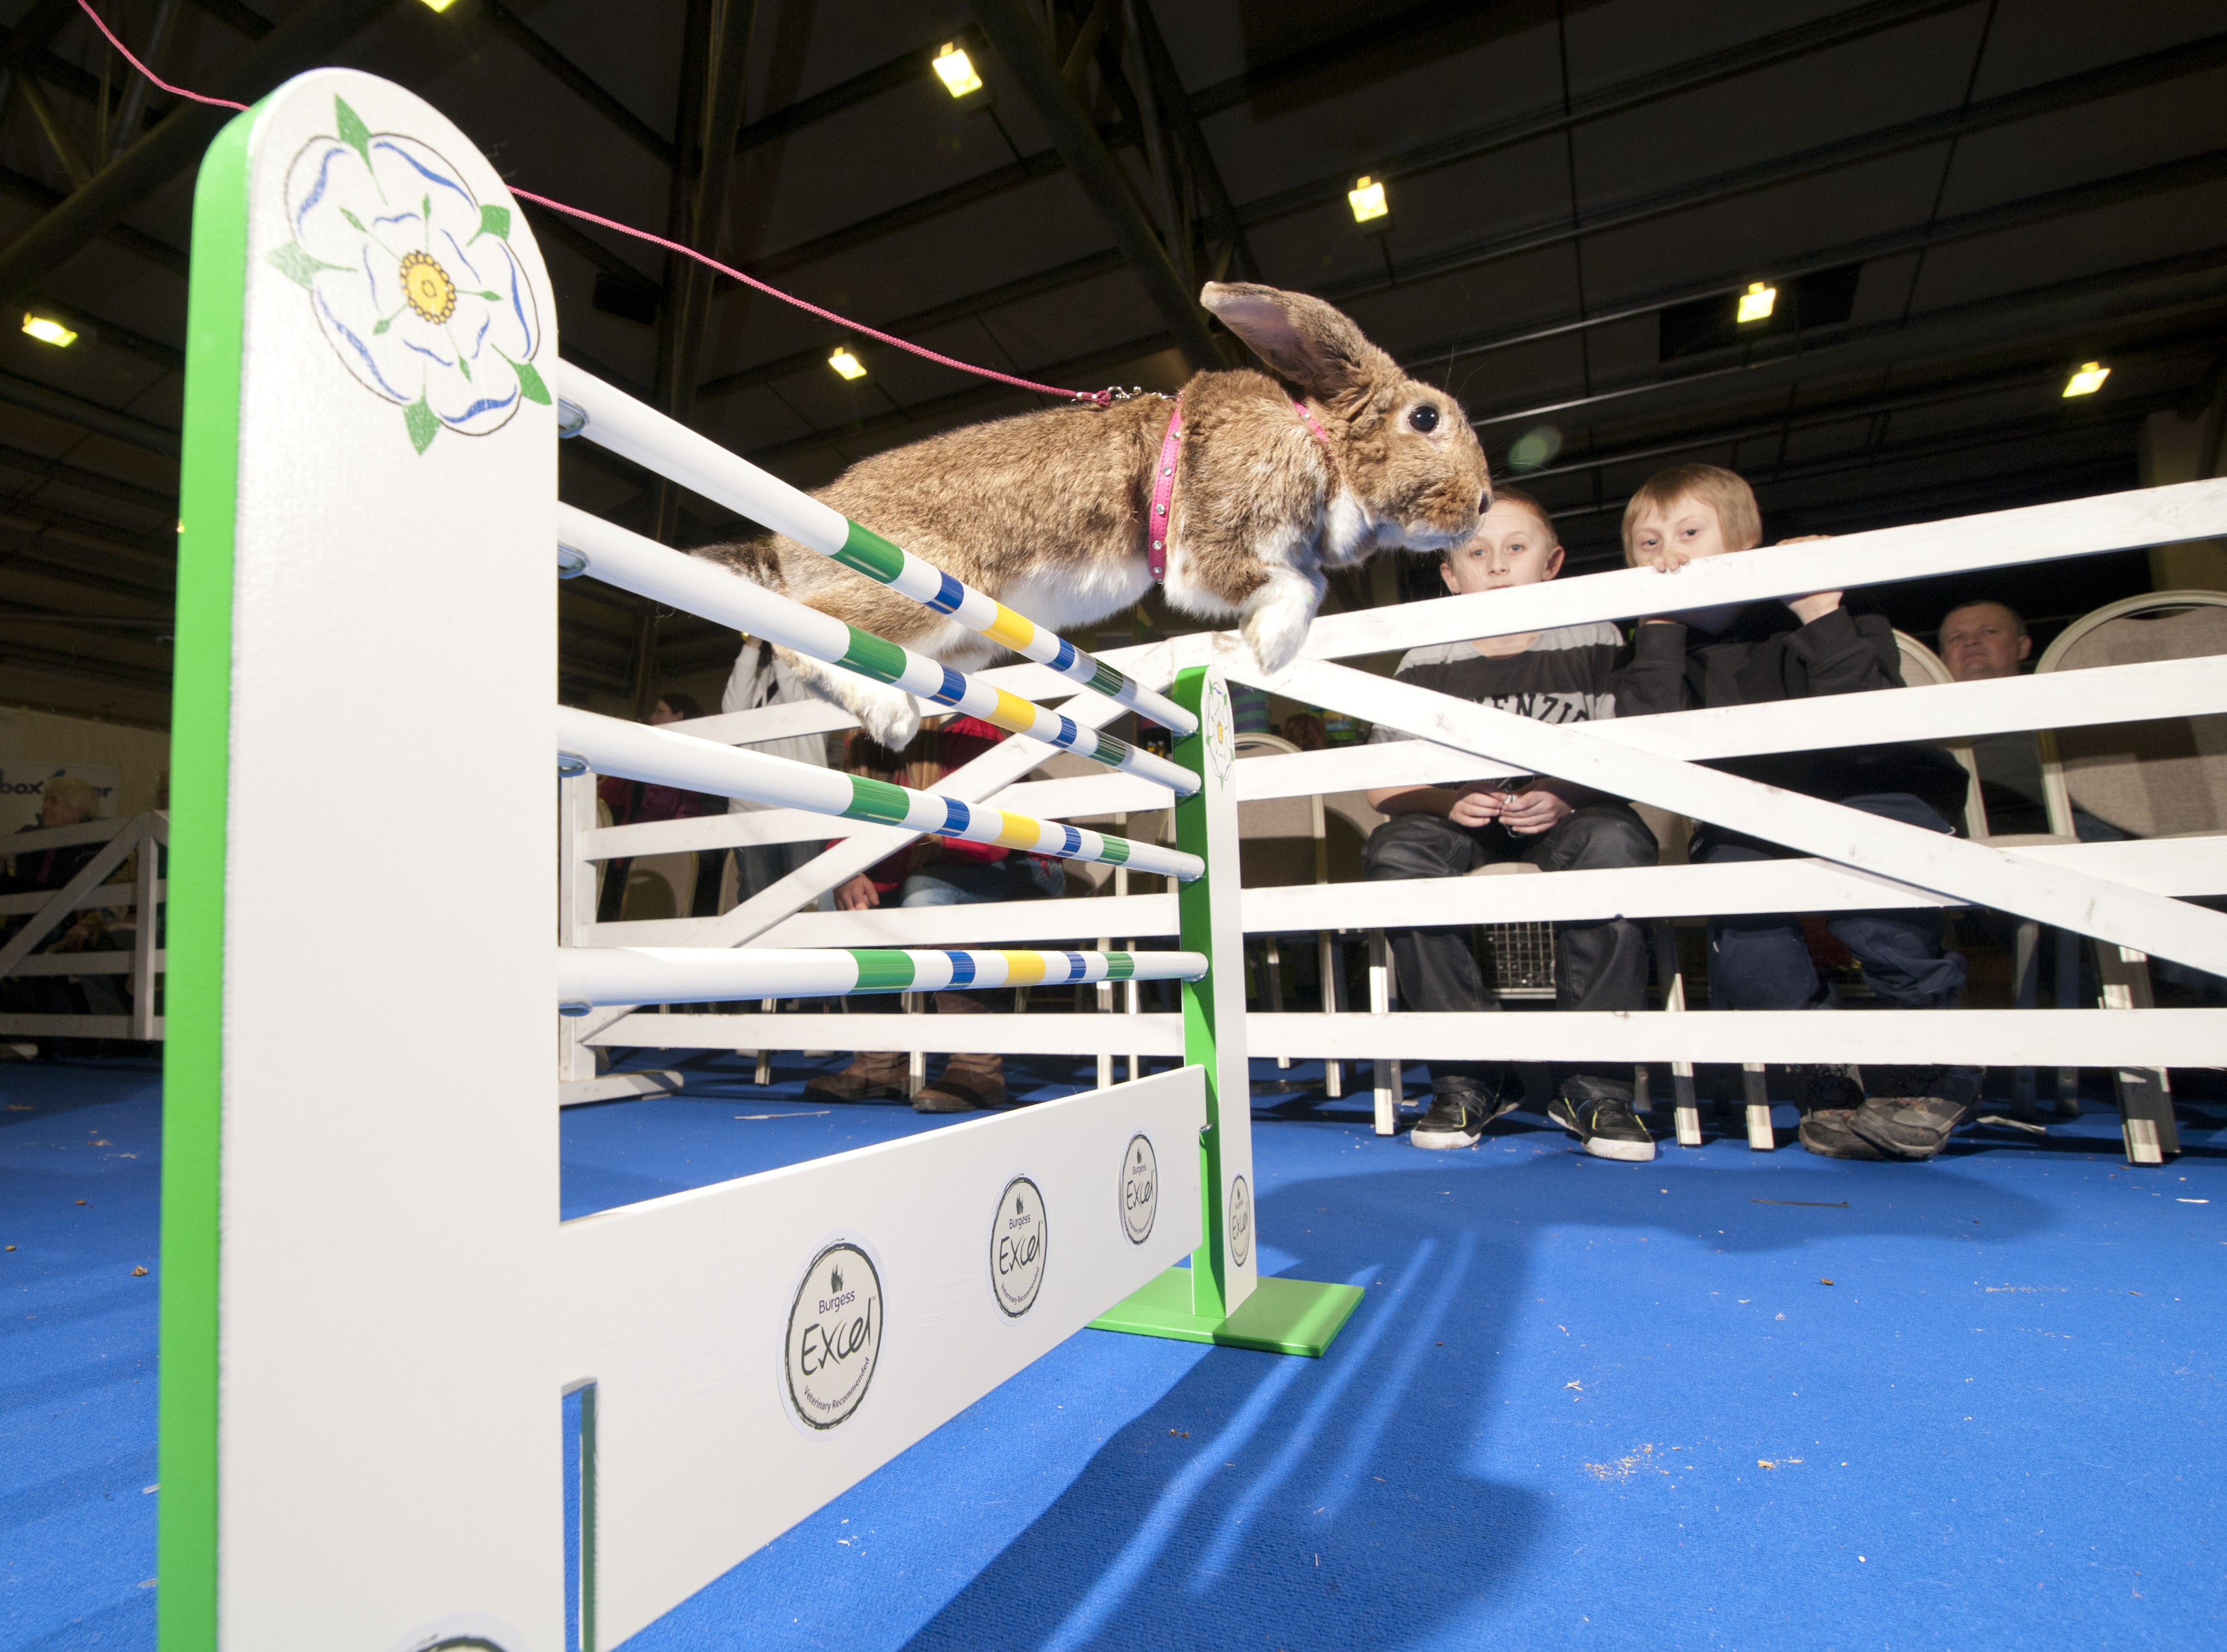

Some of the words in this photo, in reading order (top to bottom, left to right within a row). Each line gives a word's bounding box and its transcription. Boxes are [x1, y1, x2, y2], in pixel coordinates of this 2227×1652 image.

[1126, 1170, 1155, 1211] Excel
[1132, 1164, 1146, 1176] Burgess
[1009, 1214, 1031, 1230] Burgess
[999, 1221, 1040, 1275] Excel
[819, 1291, 855, 1314] Burgess
[801, 1297, 872, 1376] Excel
[804, 1384, 831, 1413] Veterinary
[832, 1357, 870, 1409] Recommended
